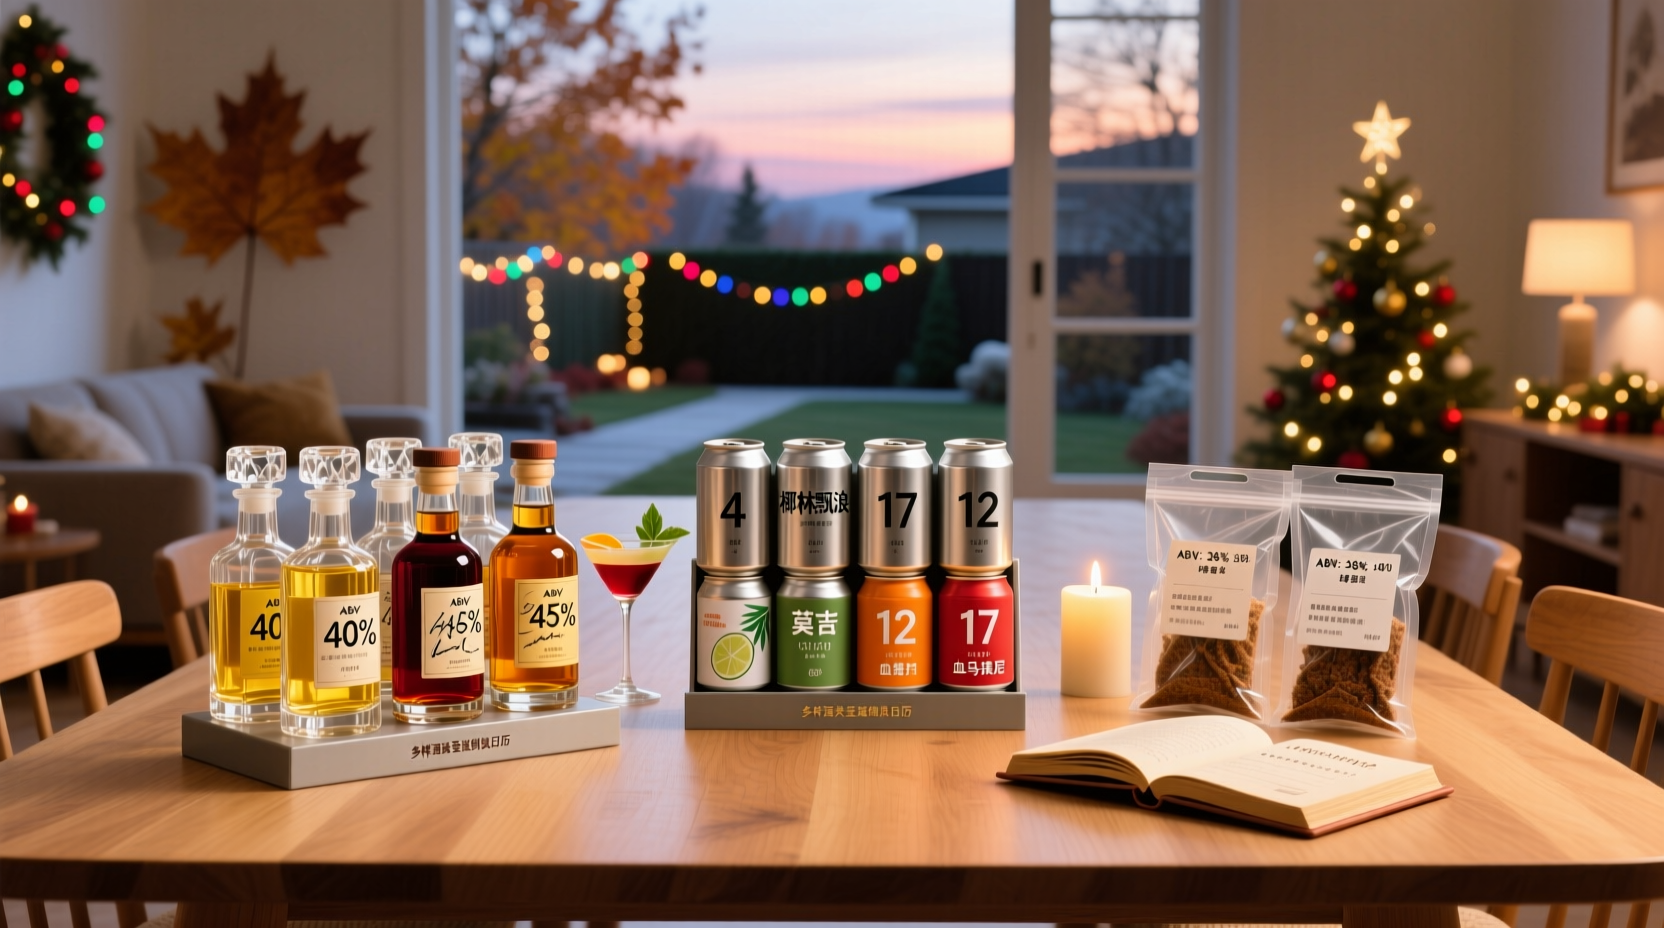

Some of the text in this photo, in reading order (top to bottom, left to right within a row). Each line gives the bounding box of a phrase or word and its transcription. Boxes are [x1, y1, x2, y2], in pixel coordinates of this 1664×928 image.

[720, 492, 746, 528] 4
[877, 492, 918, 528] 17
[958, 492, 999, 528] 12
[250, 613, 281, 640] 40
[324, 618, 376, 648] 40%
[529, 602, 576, 628] 45%
[792, 609, 838, 636] 莫吉
[877, 609, 916, 645] 12
[960, 609, 999, 645] 17
